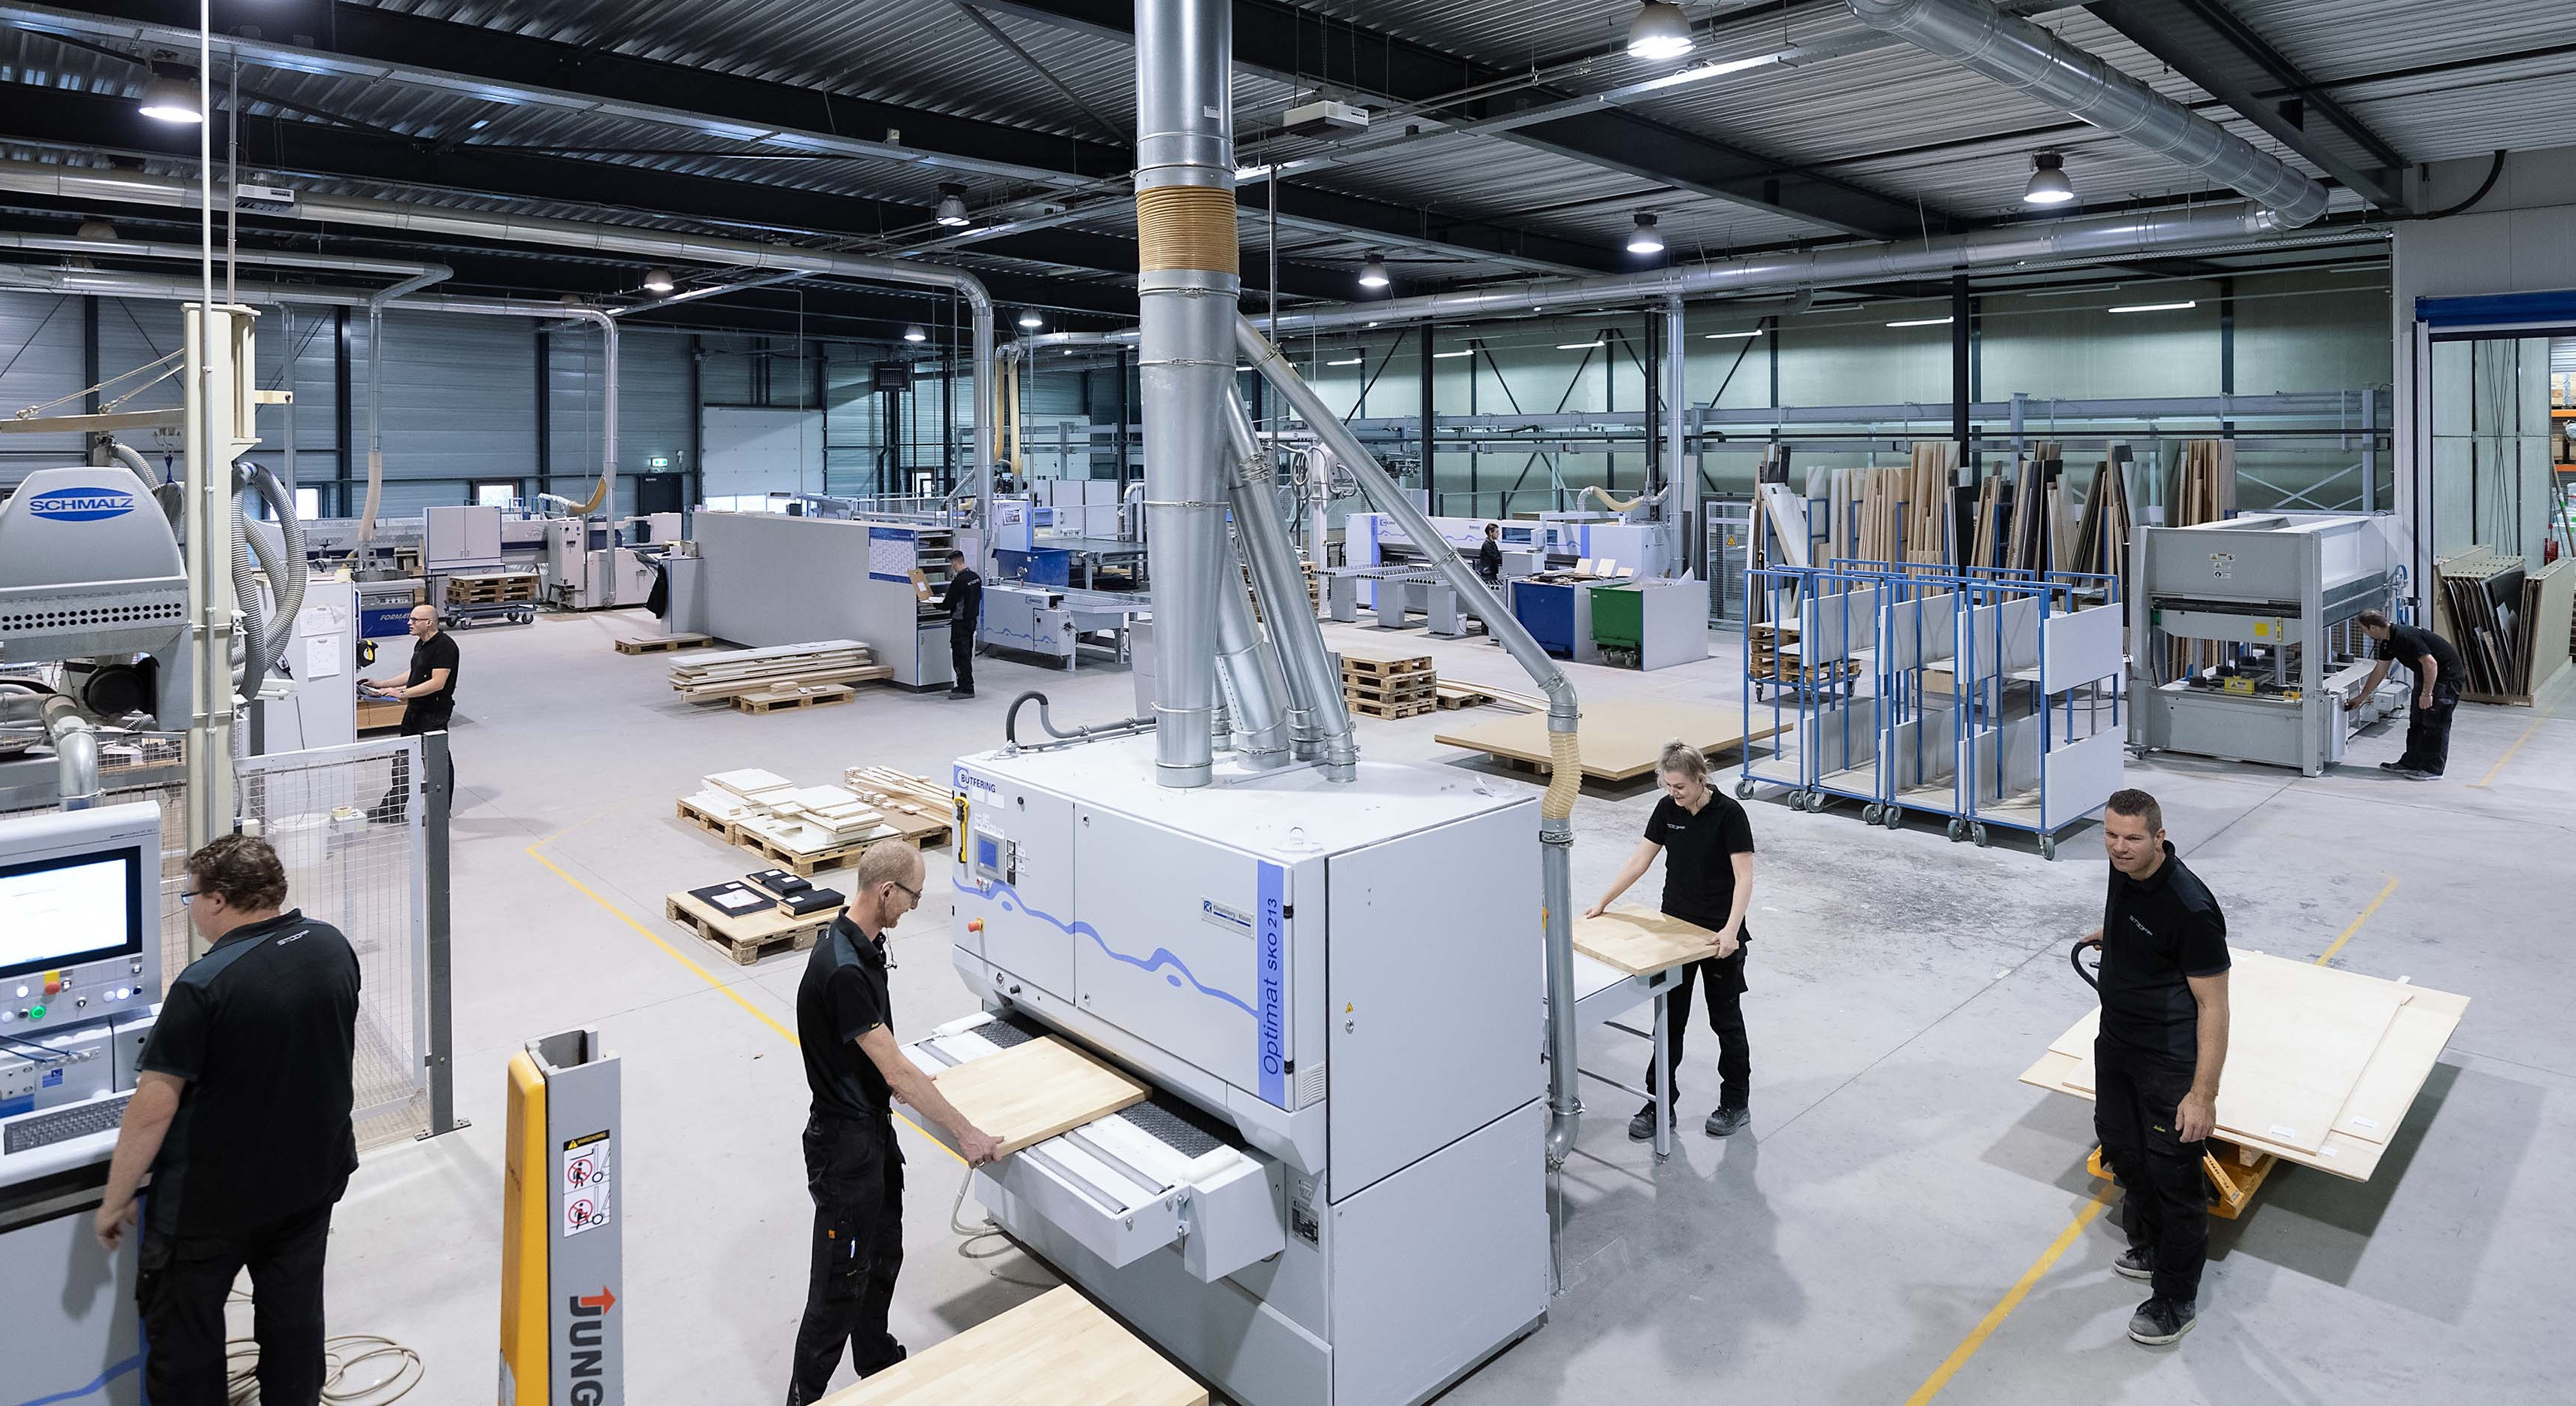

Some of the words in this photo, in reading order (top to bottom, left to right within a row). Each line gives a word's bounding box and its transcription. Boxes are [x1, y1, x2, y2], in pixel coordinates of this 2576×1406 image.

[30, 498, 135, 511] SCHMALZ
[1268, 898, 1277, 929] 213
[1268, 933, 1277, 971] SKO
[1263, 978, 1282, 1075] Optimat
[569, 1295, 604, 1406] JUNG
